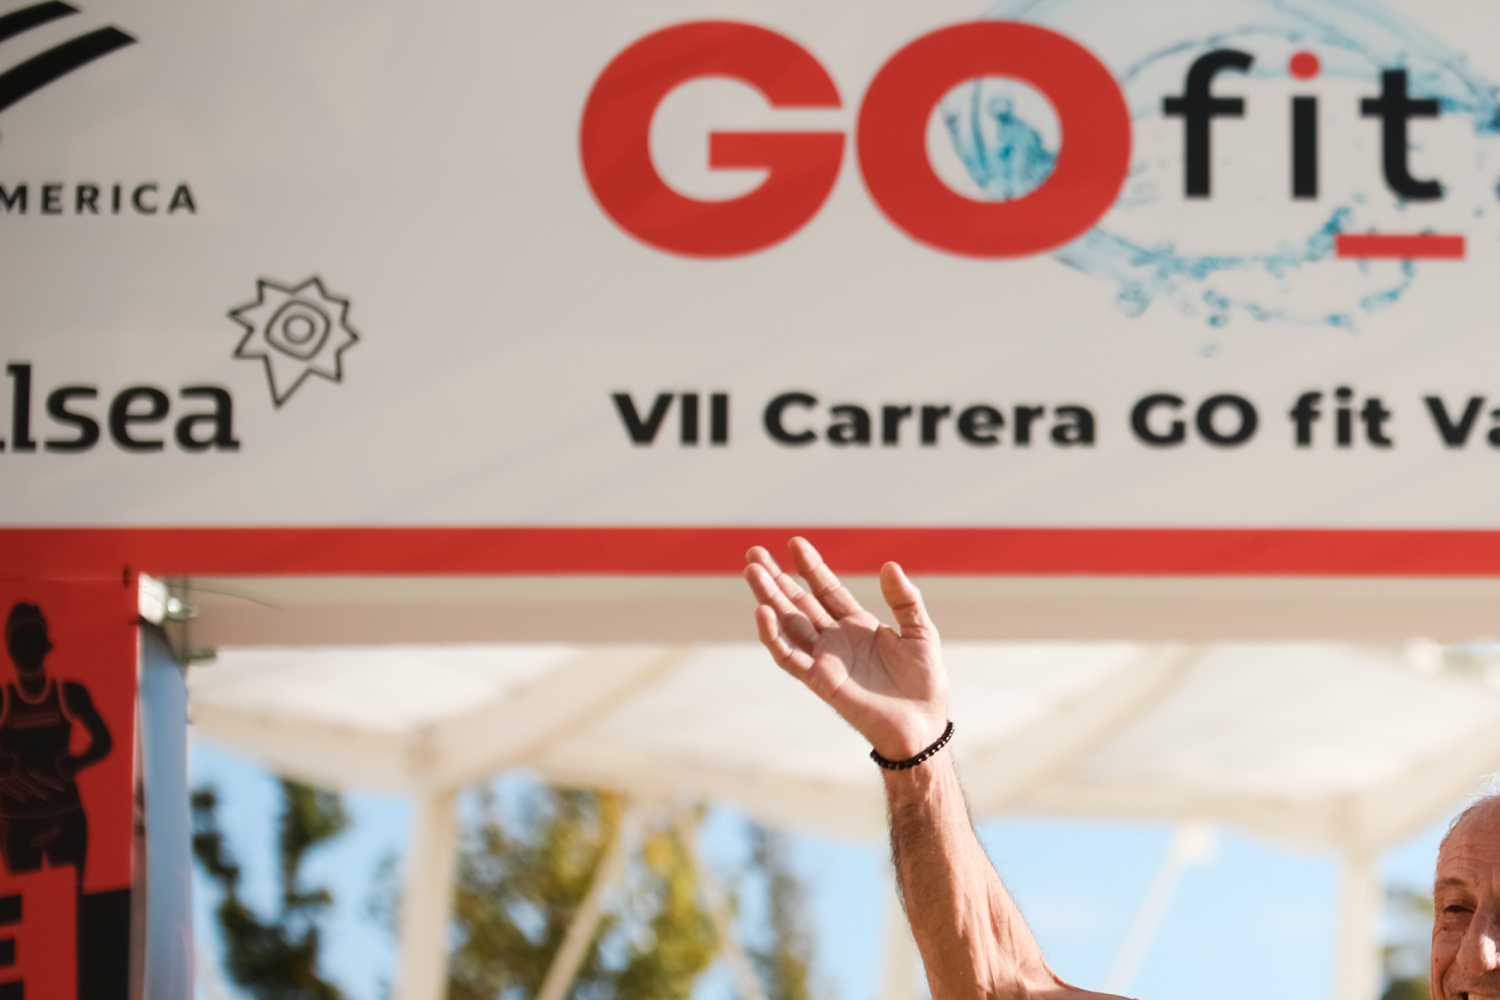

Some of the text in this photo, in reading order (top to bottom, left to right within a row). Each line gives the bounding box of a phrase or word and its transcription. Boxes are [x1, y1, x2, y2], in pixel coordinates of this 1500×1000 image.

[0, 362, 241, 454] lsea
[609, 391, 730, 447] VII
[762, 390, 1097, 448] Carrera
[1128, 392, 1260, 449] GO
[1289, 385, 1393, 448] fit
